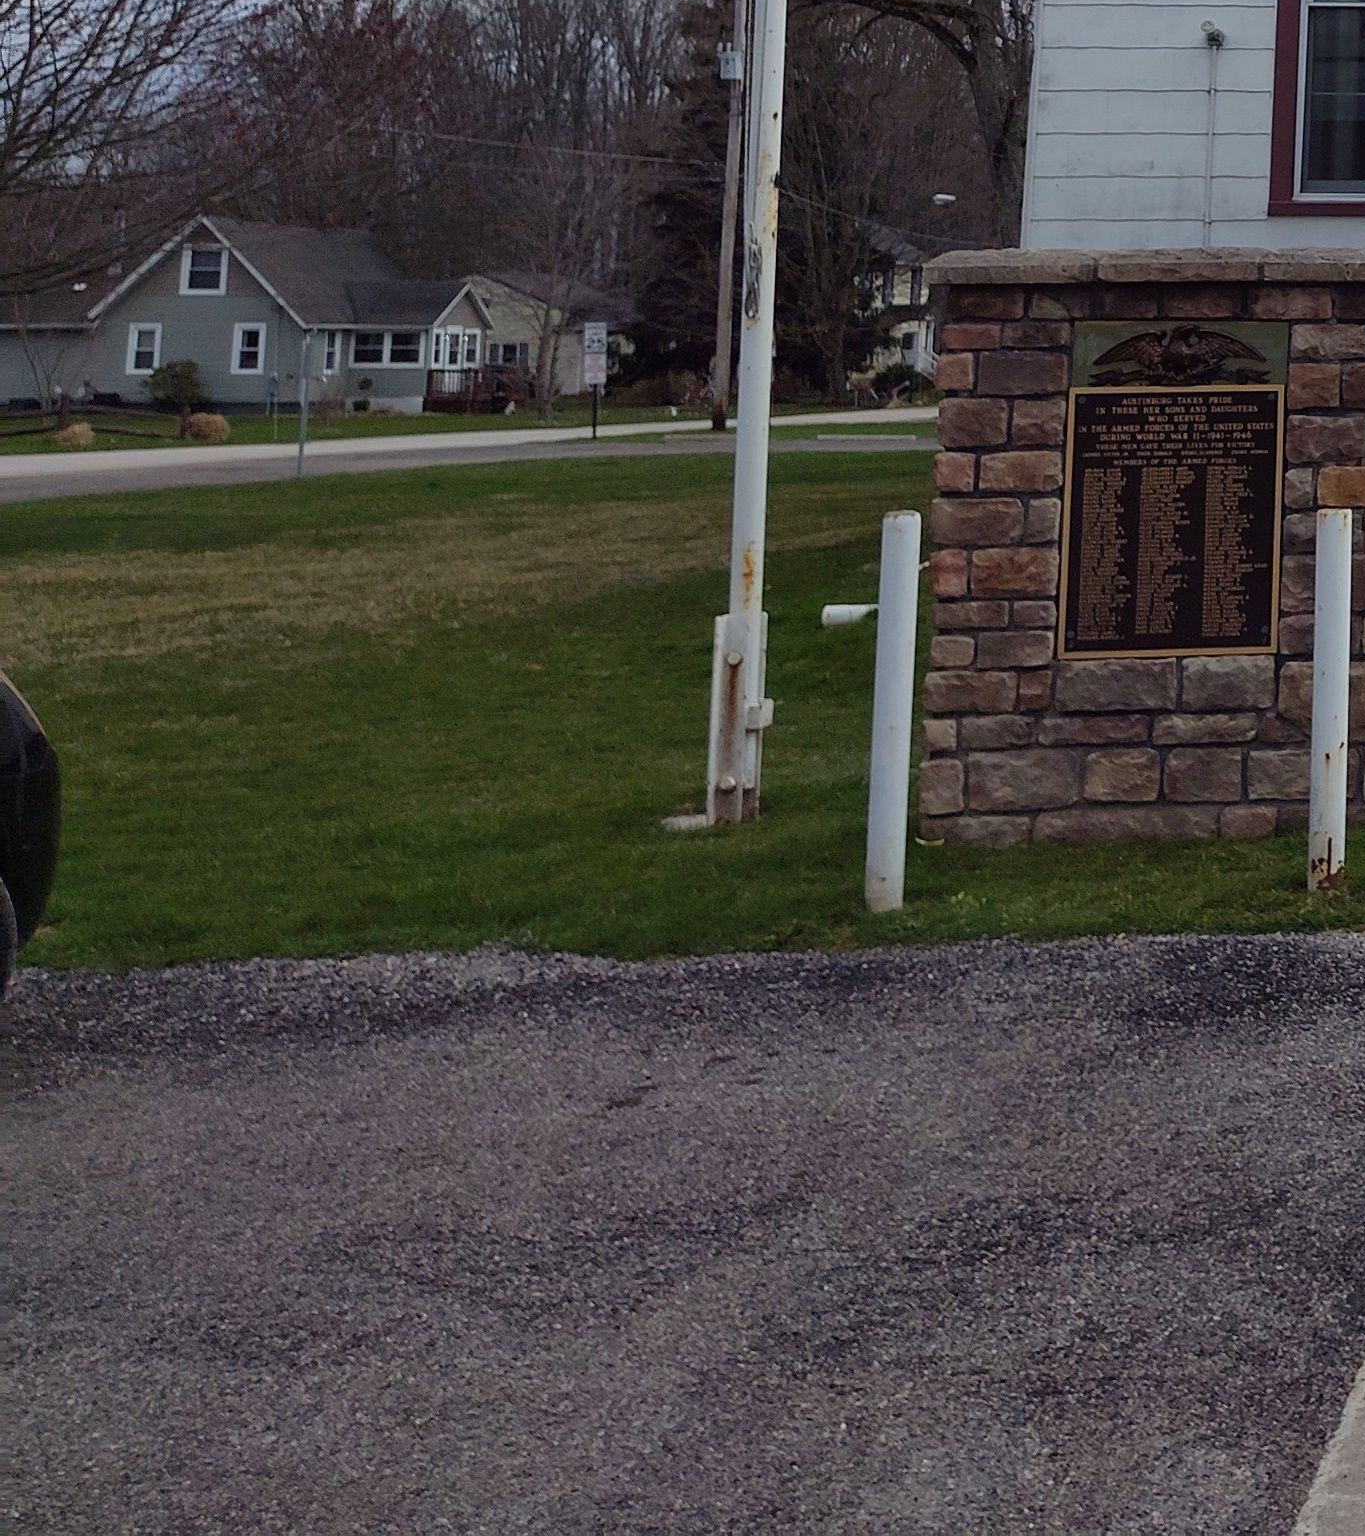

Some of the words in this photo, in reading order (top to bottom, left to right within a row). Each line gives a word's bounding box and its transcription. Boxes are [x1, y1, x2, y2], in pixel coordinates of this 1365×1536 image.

[1121, 396, 1173, 406] AUSTINBURG
[1177, 396, 1203, 404] TAKES
[1208, 396, 1233, 404] PRIDE
[1096, 406, 1106, 415] IN
[1111, 406, 1139, 415] THESE
[1143, 406, 1161, 414] HER
[1165, 406, 1186, 414] SONS
[1189, 405, 1208, 413] AND
[1211, 405, 1259, 413] DAUGHTERS
[1148, 415, 1168, 423] WHO
[1173, 414, 1207, 422] SERVED
[1078, 425, 1088, 433] IN
[1091, 425, 1107, 433] THE
[1110, 424, 1140, 432] ARMED
[1144, 424, 1174, 432] FORCES
[1178, 423, 1188, 431] OF
[1193, 423, 1210, 431] THE
[1213, 422, 1244, 430] UNITED
[1246, 422, 1275, 430] STATES
[1100, 433, 1131, 441] DURING
[1135, 433, 1166, 441] WORLD
[1170, 432, 1188, 440] WAR
